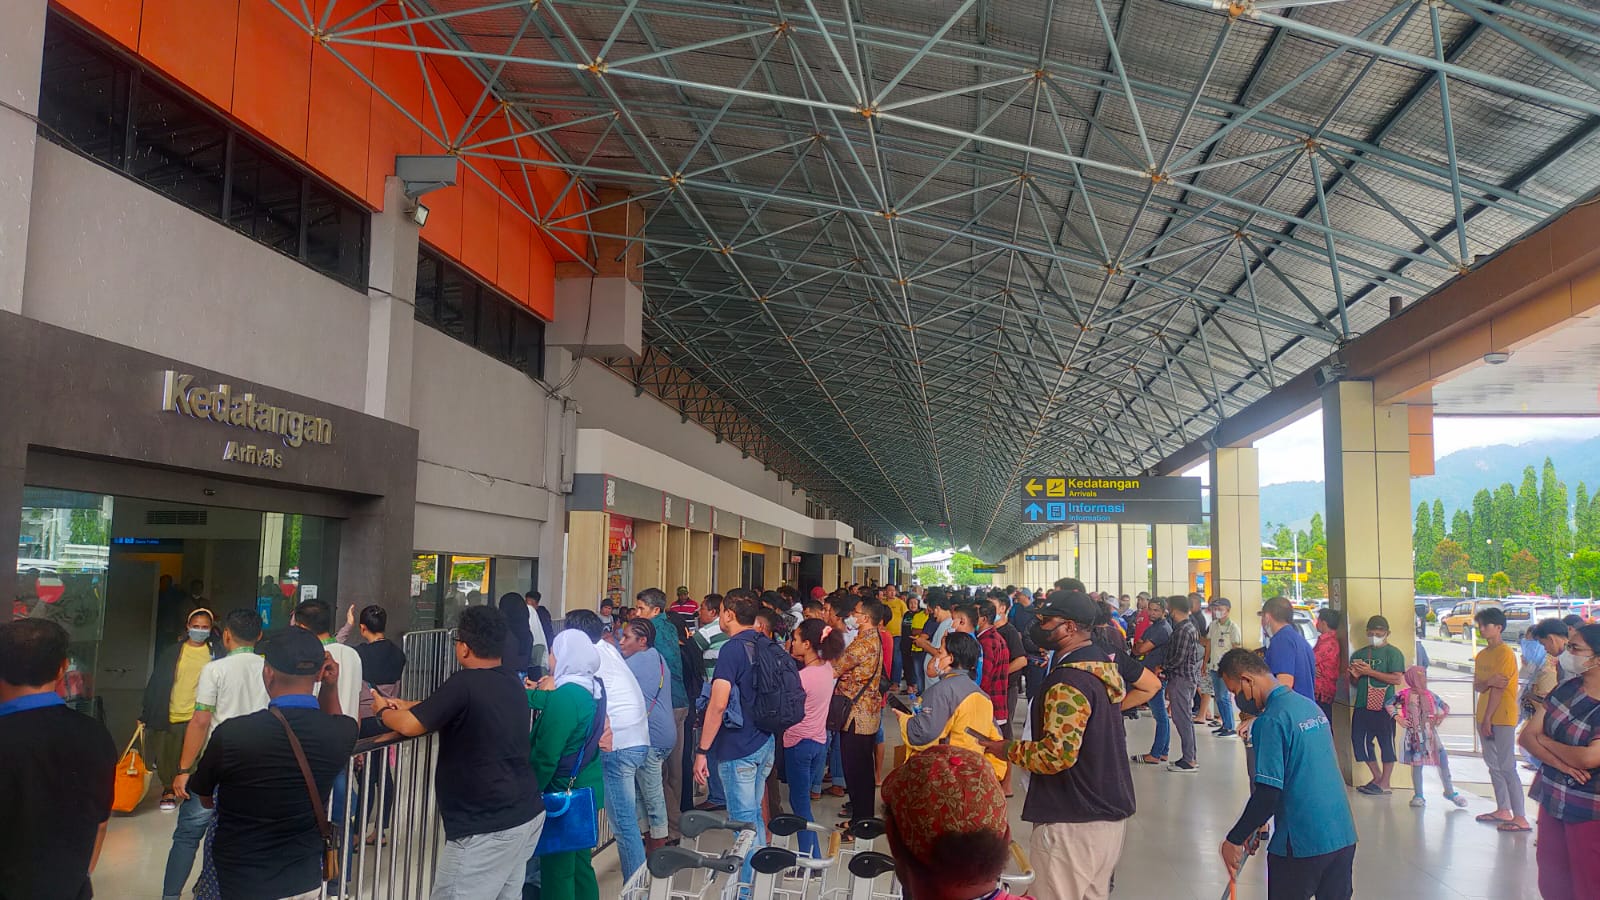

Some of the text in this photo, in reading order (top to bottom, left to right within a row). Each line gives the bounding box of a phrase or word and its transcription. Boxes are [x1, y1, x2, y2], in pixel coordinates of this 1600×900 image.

[163, 370, 333, 447] Kedatangan
[223, 441, 284, 469] Arrivals
[1068, 478, 1140, 491] Kedatangan
[1068, 503, 1125, 513] Informasi
[1069, 514, 1111, 522] Information
